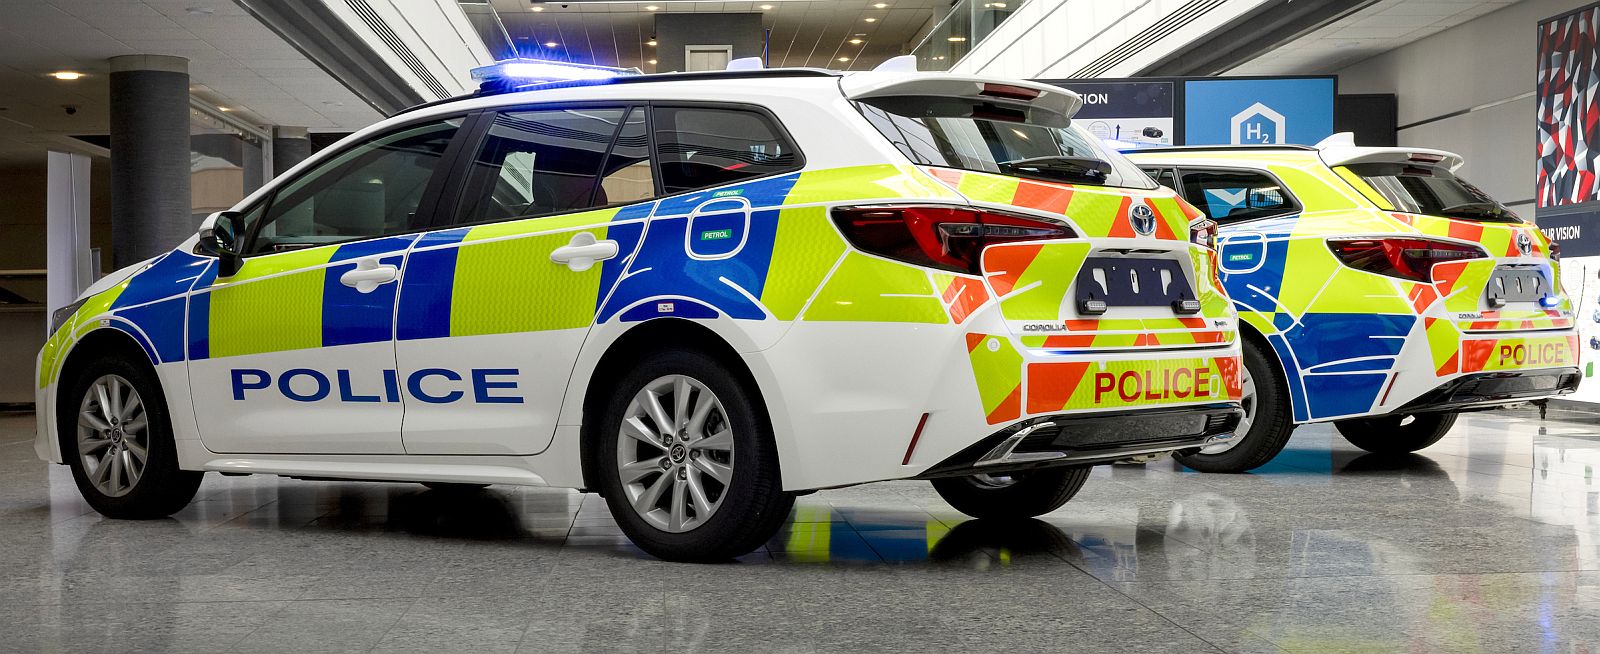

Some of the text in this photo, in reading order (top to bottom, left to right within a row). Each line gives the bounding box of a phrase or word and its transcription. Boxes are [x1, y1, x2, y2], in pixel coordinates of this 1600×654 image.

[704, 230, 729, 239] PETROL
[1555, 225, 1581, 241] VISION
[1499, 343, 1564, 366] POLICE
[230, 368, 525, 404] POLICE
[1094, 367, 1211, 404] POLICE
